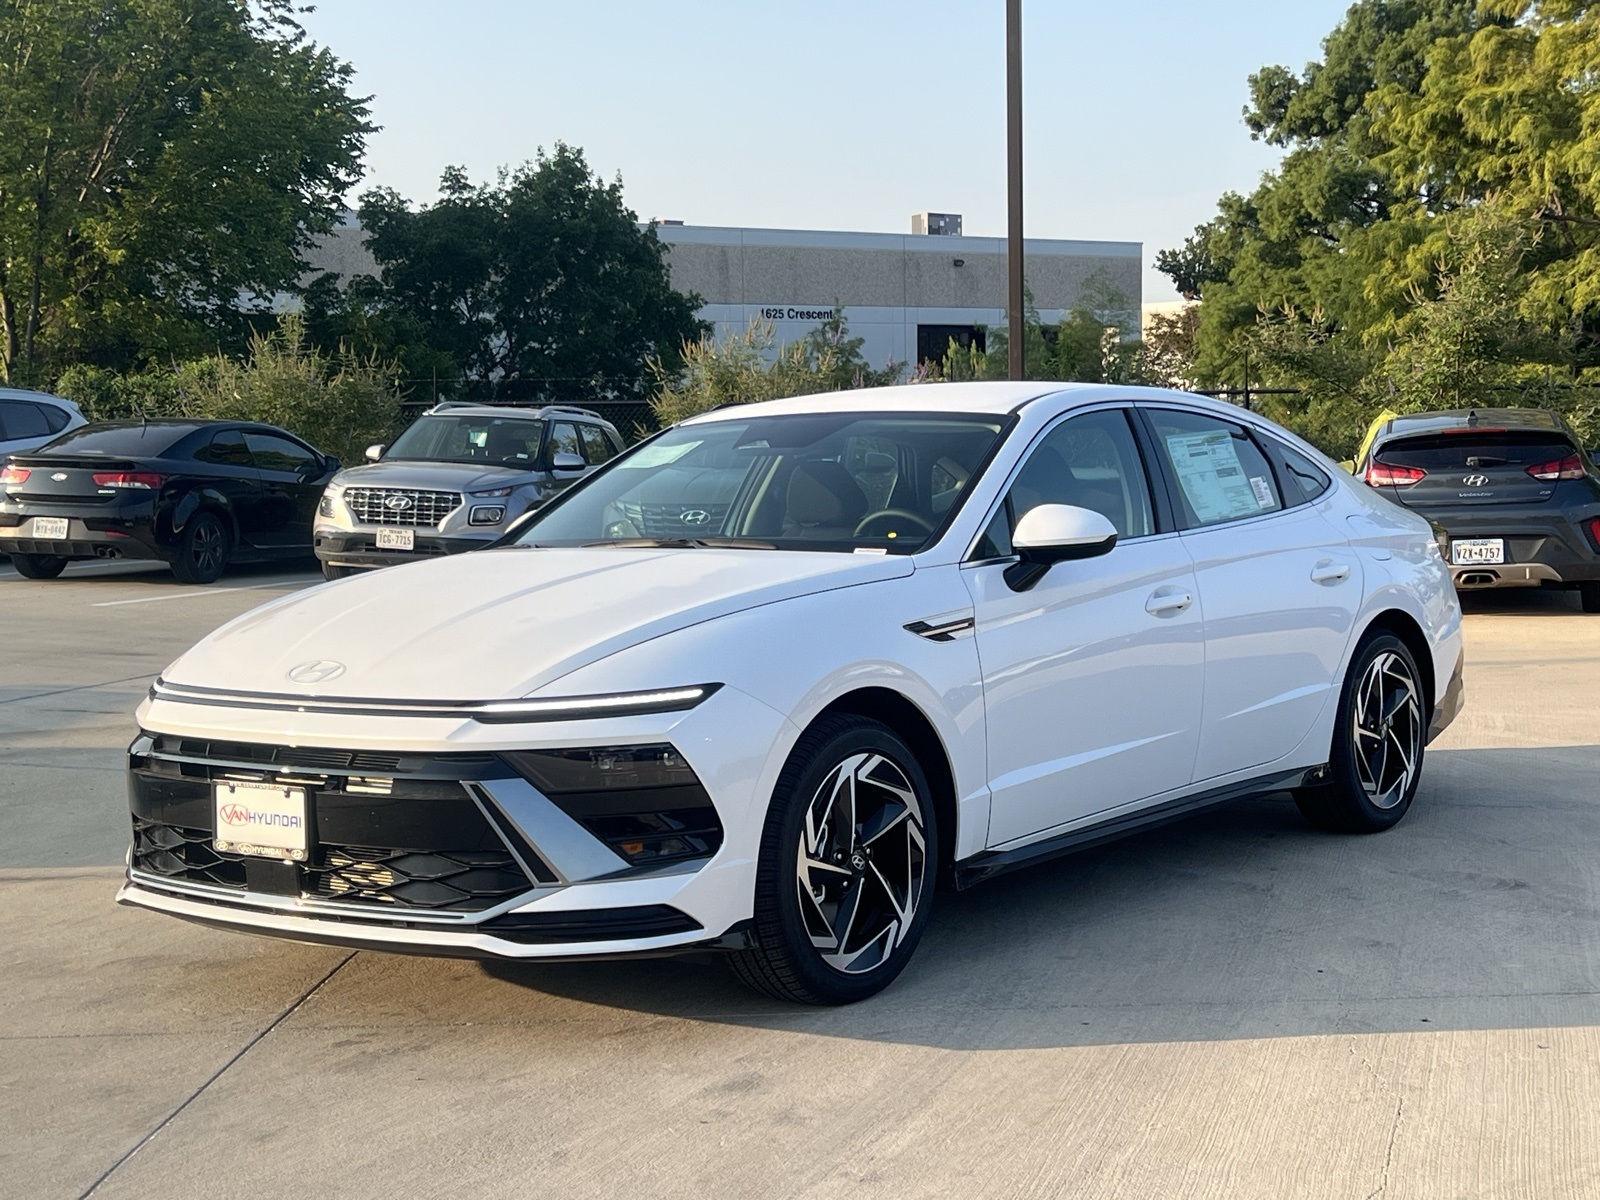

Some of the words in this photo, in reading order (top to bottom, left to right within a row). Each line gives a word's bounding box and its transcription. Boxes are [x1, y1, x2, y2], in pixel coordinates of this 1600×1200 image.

[761, 308, 784, 319] 1625
[787, 308, 833, 319] Crescent
[249, 811, 302, 828] HYUNDAI
